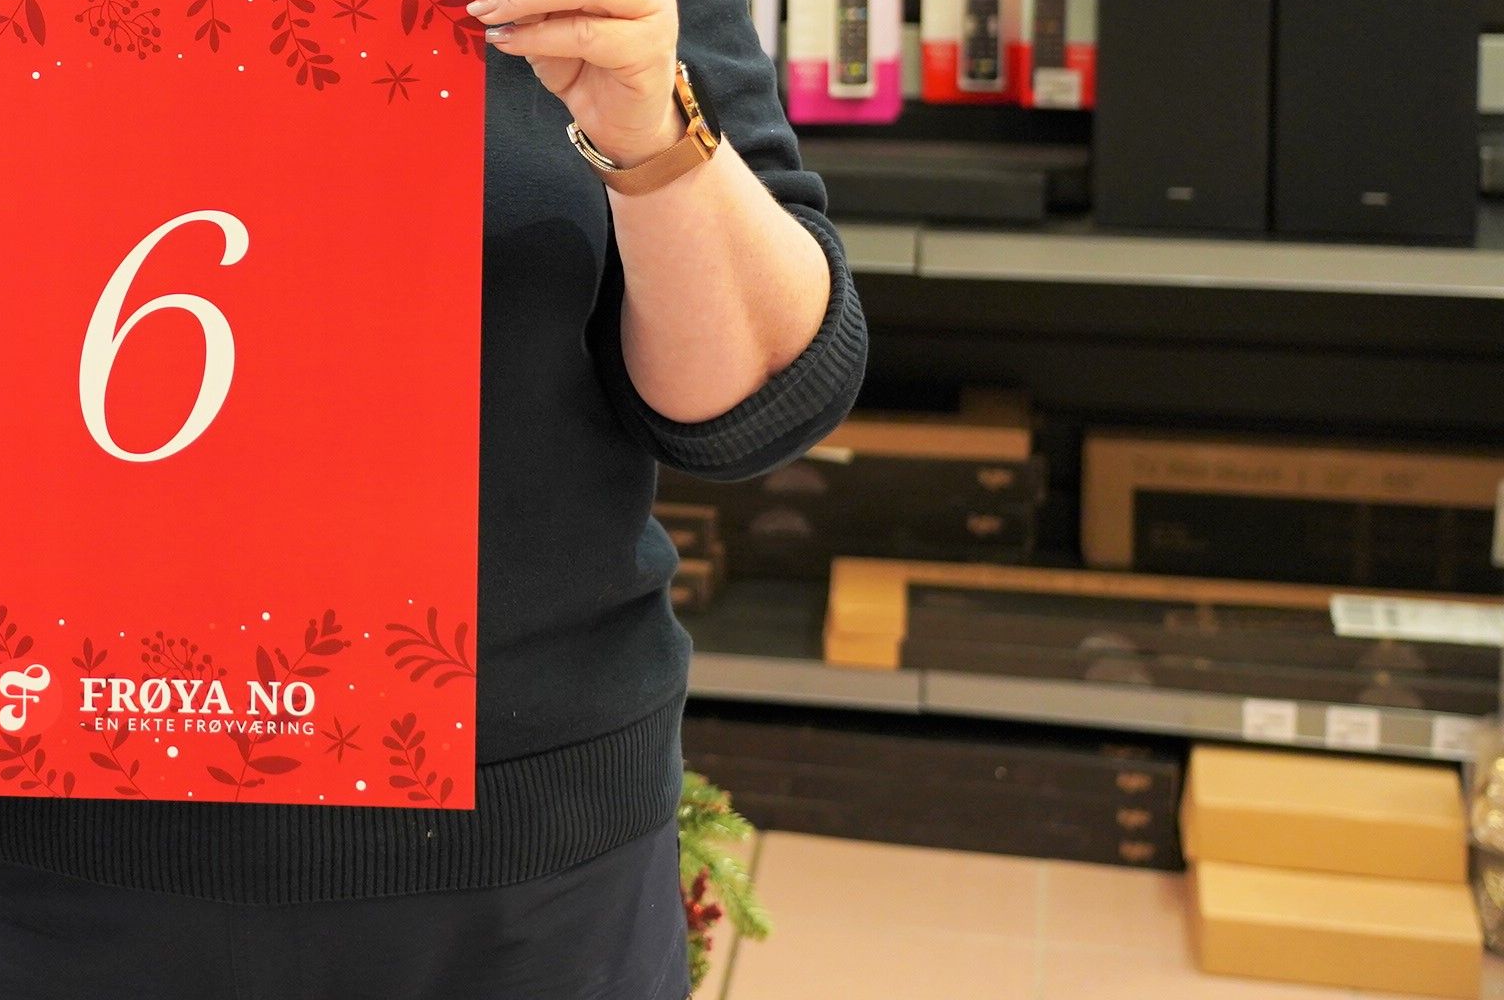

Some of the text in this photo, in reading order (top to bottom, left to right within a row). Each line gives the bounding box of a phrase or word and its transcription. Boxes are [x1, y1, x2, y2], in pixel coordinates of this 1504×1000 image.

[79, 209, 250, 462] 6
[79, 677, 316, 717] FRØYA NO
[94, 717, 120, 731] EN
[128, 717, 176, 733] EKTE
[184, 718, 315, 736] FRØYVÆRING
